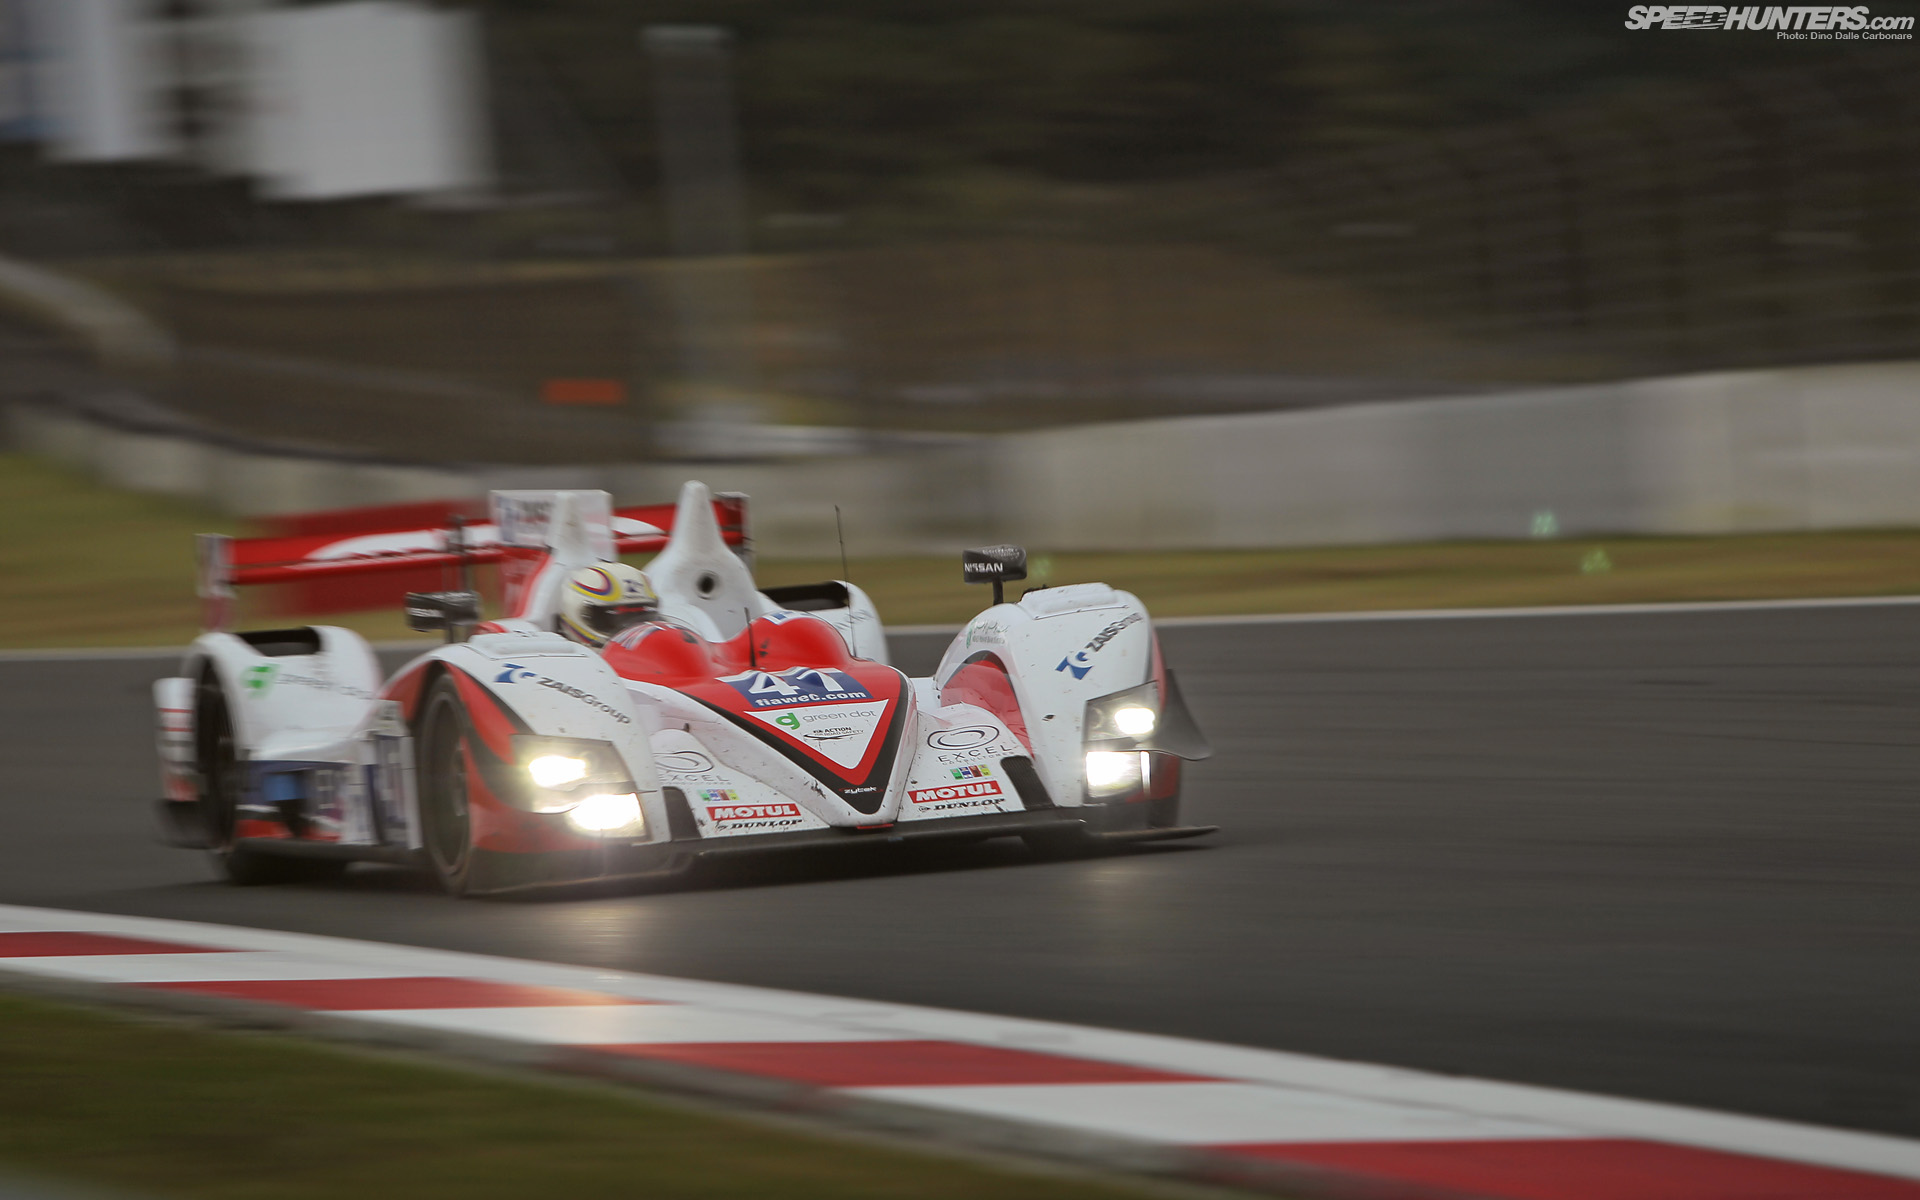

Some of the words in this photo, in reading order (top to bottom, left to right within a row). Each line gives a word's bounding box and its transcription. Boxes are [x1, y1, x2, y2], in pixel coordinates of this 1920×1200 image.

[964, 562, 1003, 573] NISSAN
[748, 668, 844, 695] 41
[755, 691, 866, 706] fiawec.com
[802, 712, 847, 723] green
[850, 710, 876, 718] dot
[824, 726, 852, 734] ACTION
[938, 744, 1012, 762] EXCEL
[916, 783, 998, 801] MOTUL
[934, 798, 1005, 811] DUNLOP
[714, 805, 796, 819] MOTUL
[730, 819, 803, 829] DUNLOP
